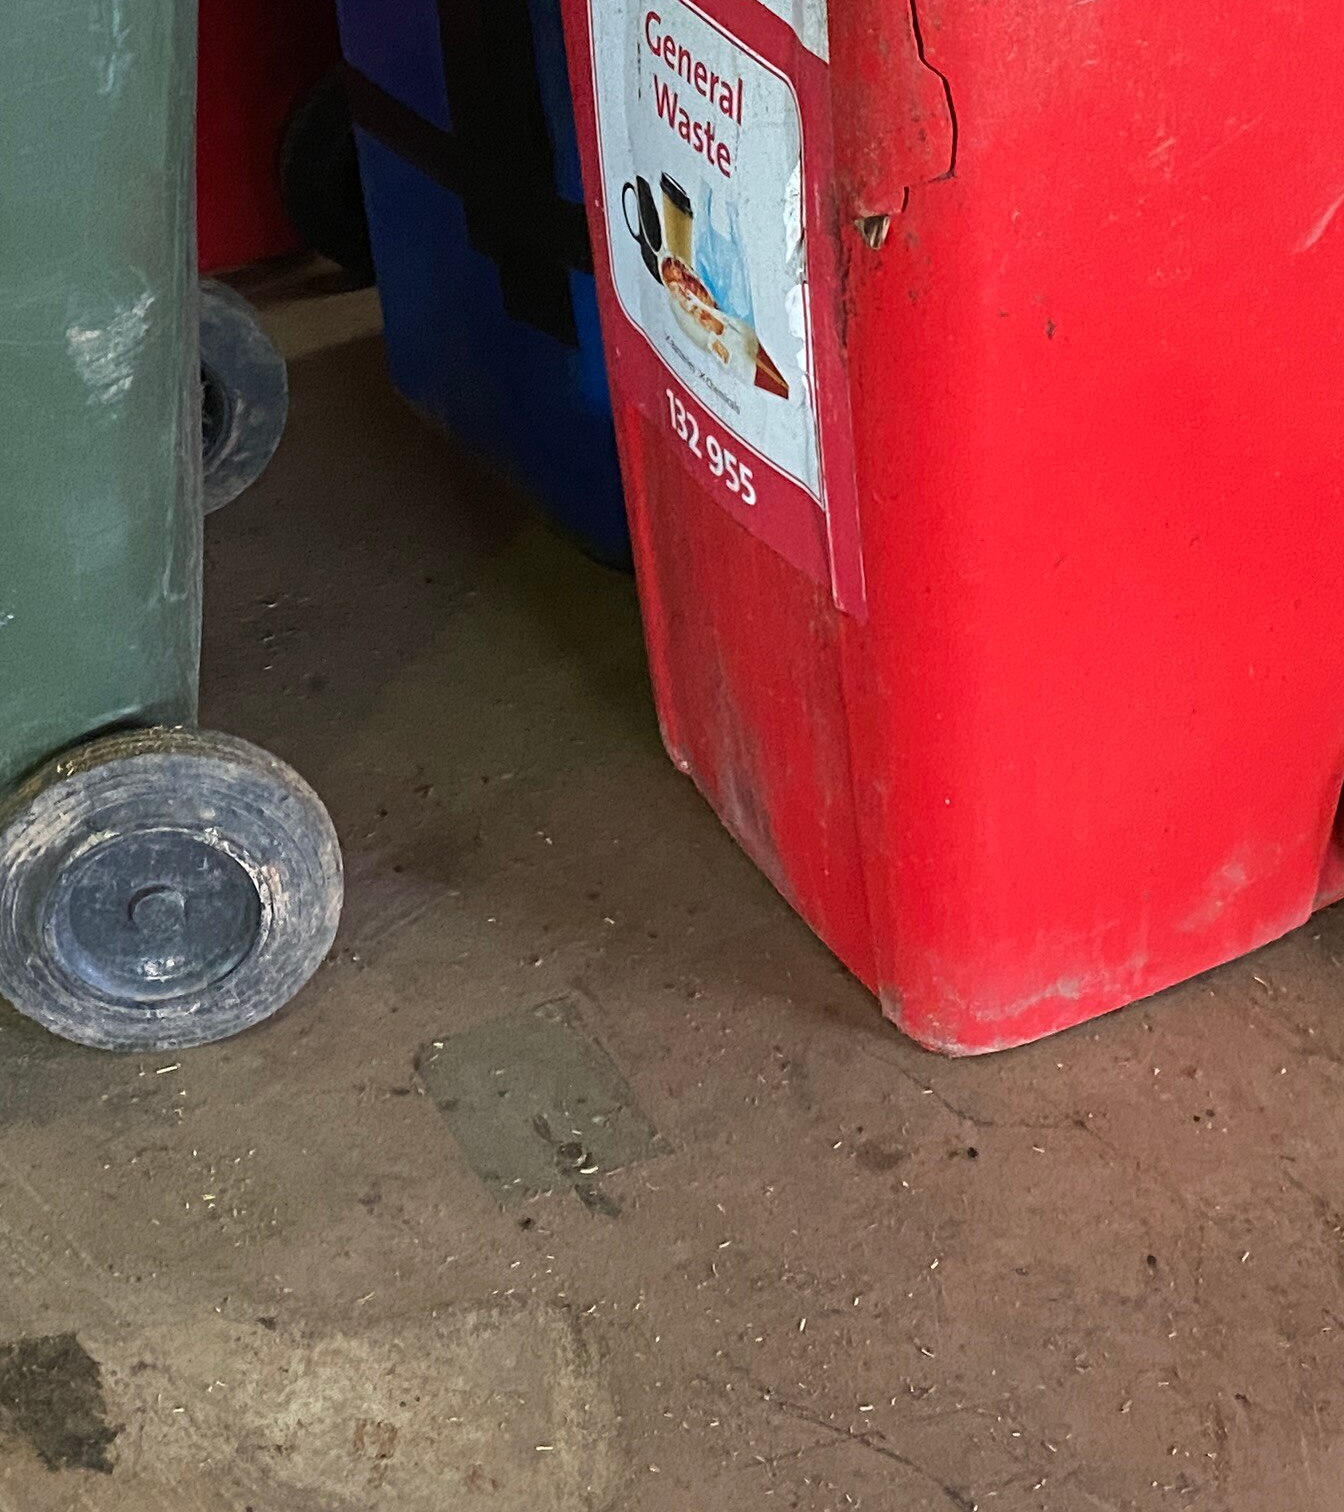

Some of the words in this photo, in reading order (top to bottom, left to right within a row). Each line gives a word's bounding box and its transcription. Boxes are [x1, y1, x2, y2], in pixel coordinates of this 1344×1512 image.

[645, 11, 743, 126] General
[653, 73, 731, 178] Waste
[666, 389, 703, 459] 132
[706, 435, 756, 505] 955
